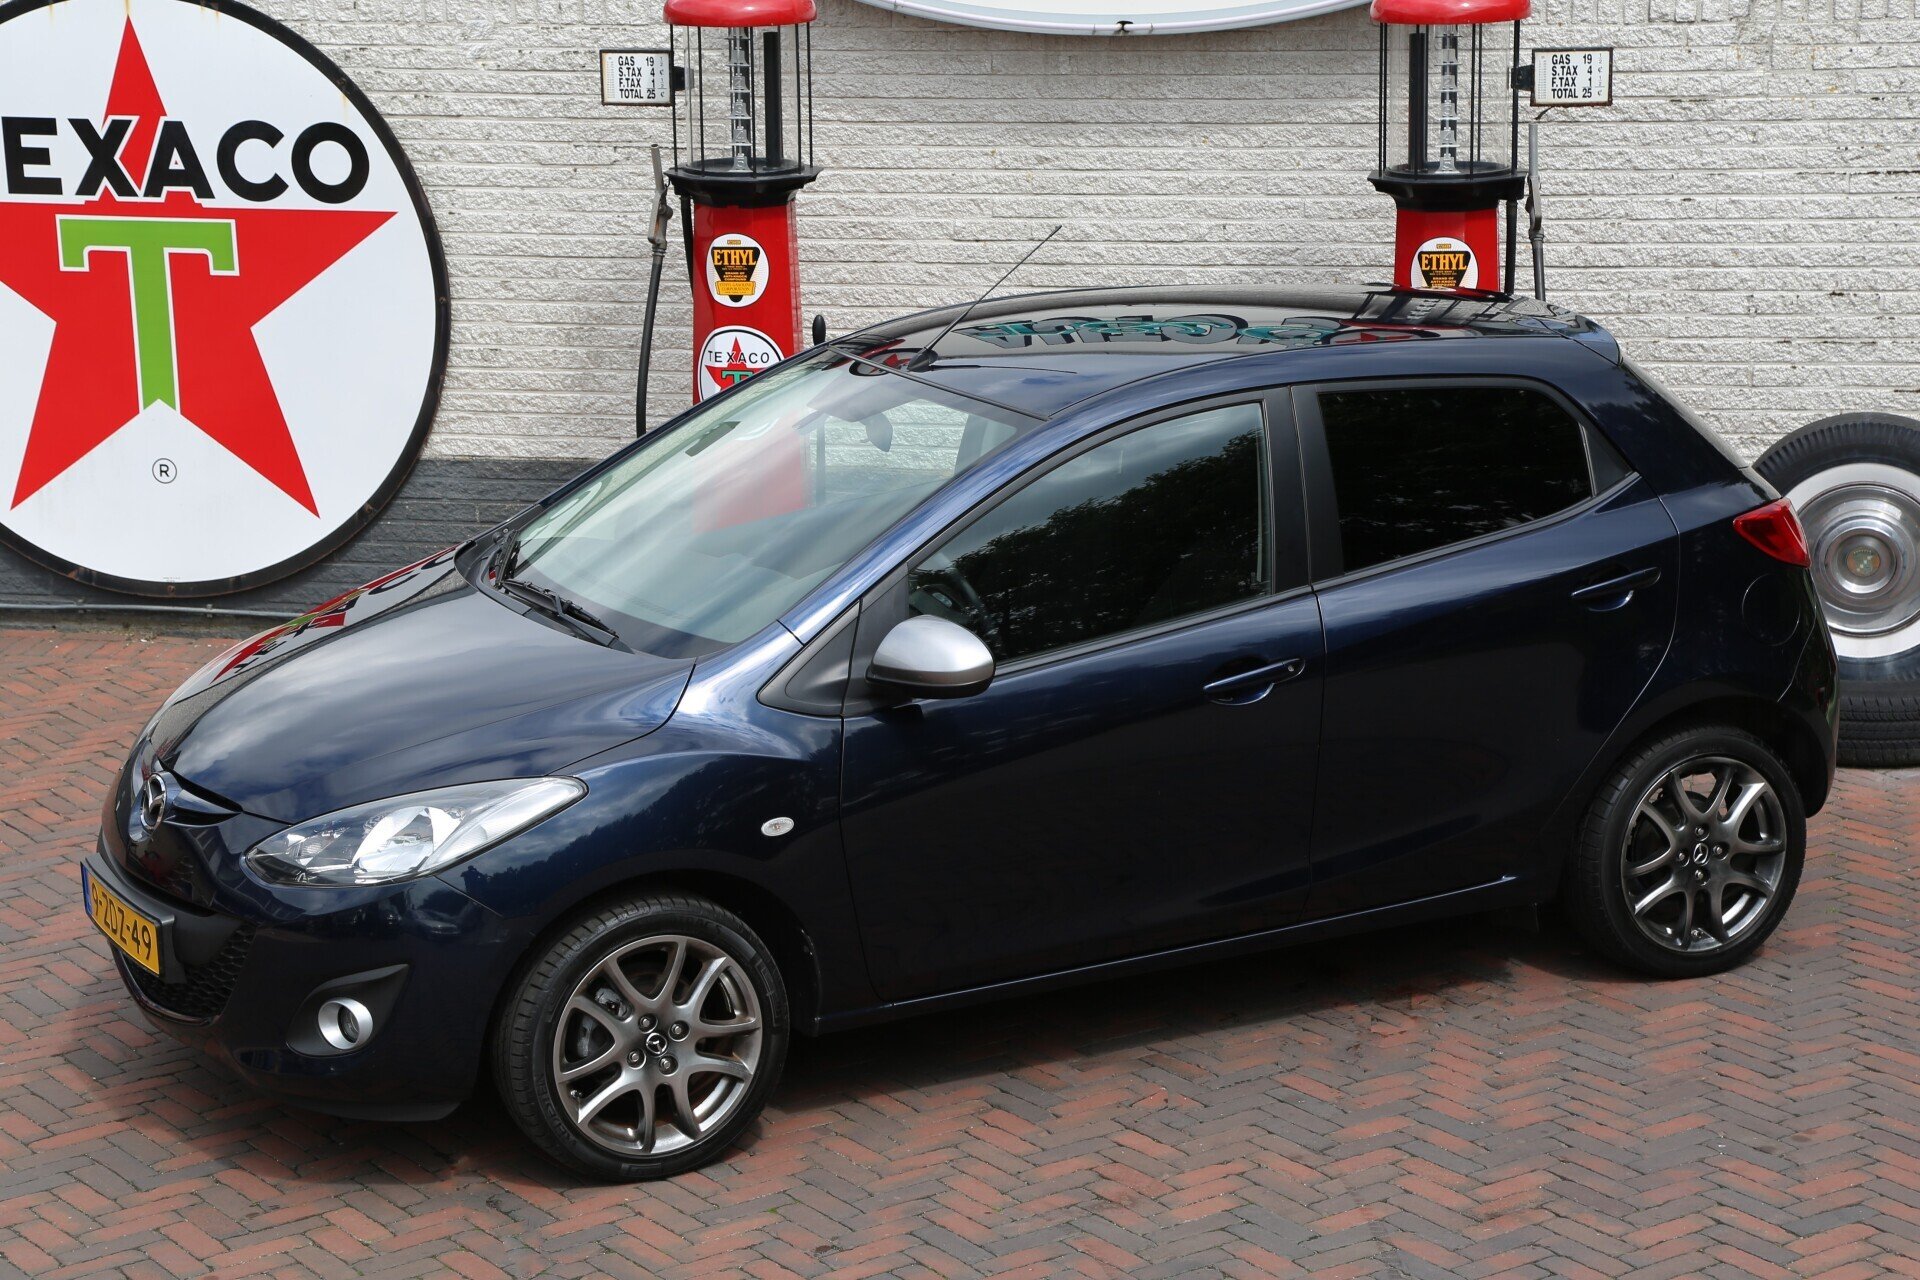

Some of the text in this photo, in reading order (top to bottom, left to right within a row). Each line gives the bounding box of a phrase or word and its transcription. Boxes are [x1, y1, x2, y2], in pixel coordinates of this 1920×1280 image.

[618, 56, 635, 66] GAS
[646, 57, 654, 67] 19
[1552, 54, 1571, 65] GAS
[1583, 54, 1592, 64] 19
[618, 67, 642, 77] S.TAX
[650, 68, 655, 77] 4
[1552, 66, 1578, 76] S.TAX
[1587, 66, 1592, 76] 4
[619, 78, 641, 88] F.TAX
[1552, 77, 1576, 87] F.TAX
[619, 89, 643, 99] TOTAL
[646, 89, 656, 99] 25
[1552, 88, 1578, 99] TOTAL
[1582, 88, 1592, 98] 25
[713, 249, 756, 265] ETHYL
[1421, 253, 1466, 270] ETHYL
[59, 218, 238, 411] T
[708, 350, 770, 364] TEXACO
[91, 882, 152, 960] 9-ZDZ-49
